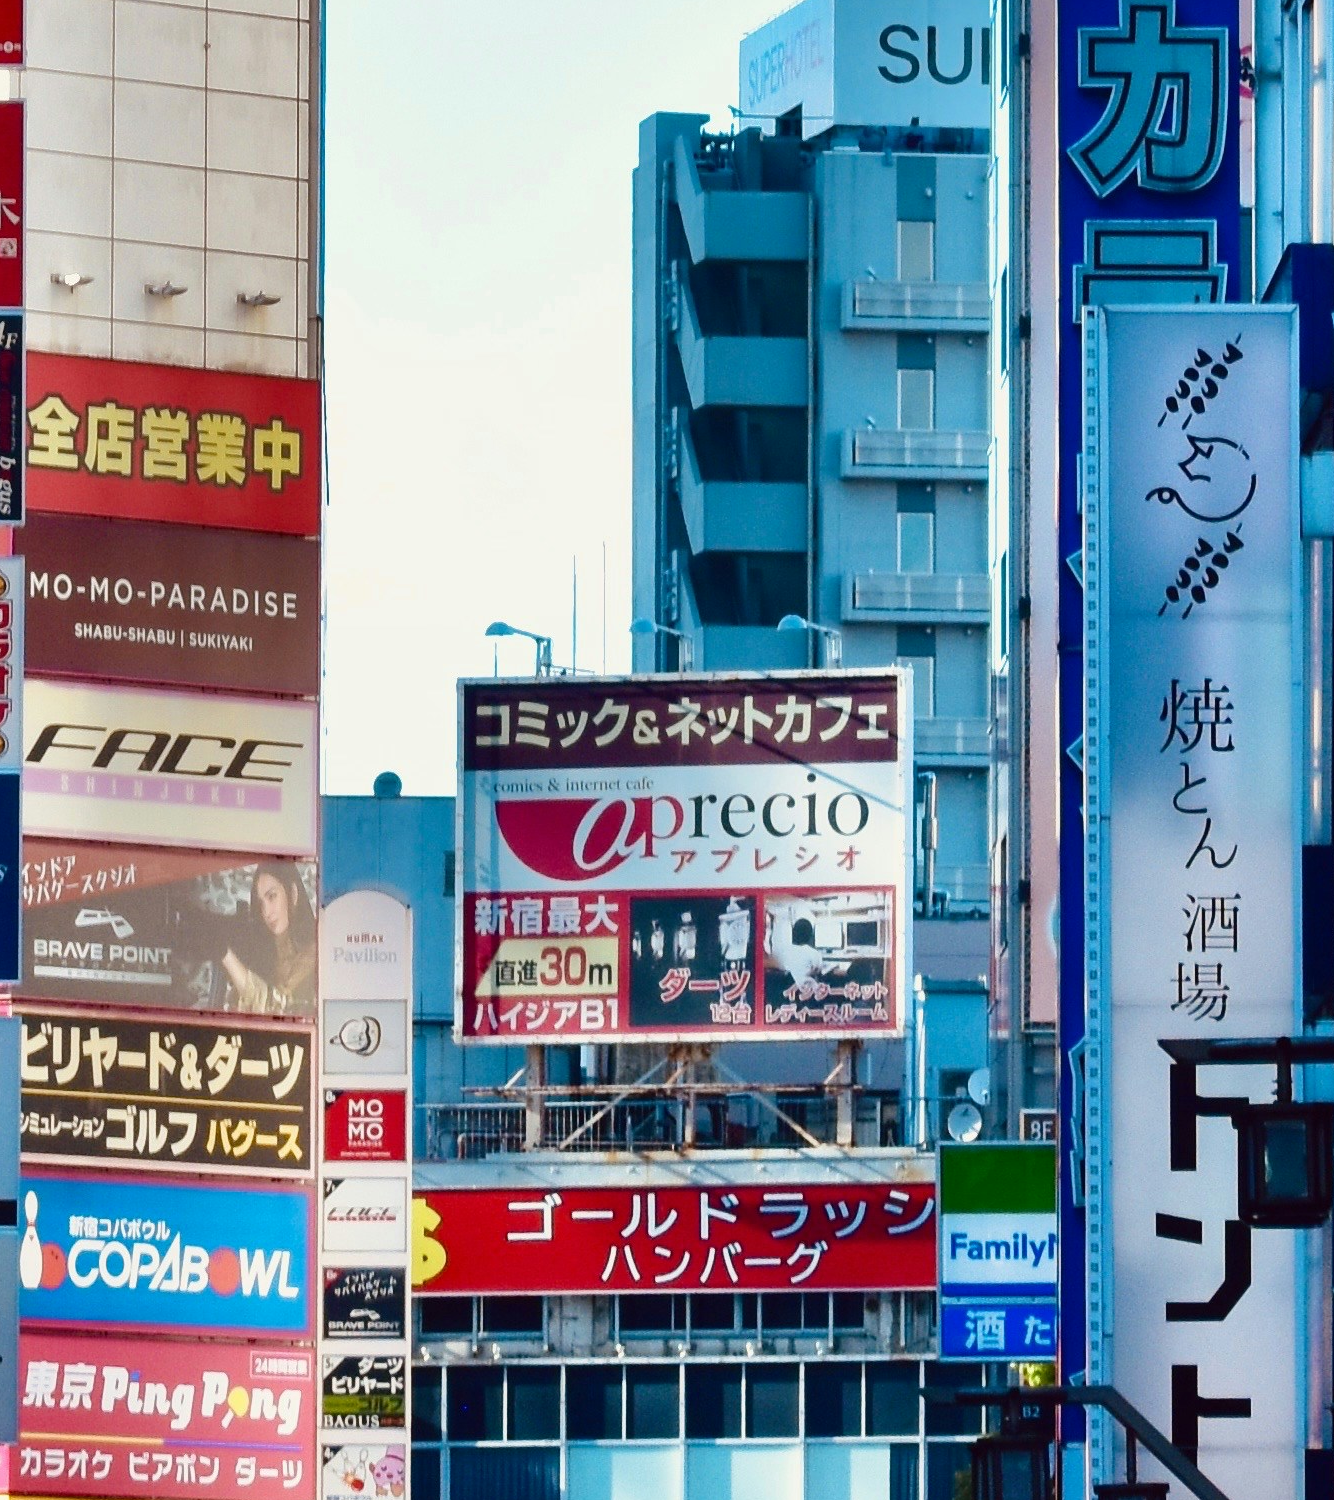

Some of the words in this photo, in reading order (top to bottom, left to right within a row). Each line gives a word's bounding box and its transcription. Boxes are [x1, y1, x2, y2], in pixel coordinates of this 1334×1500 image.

[25, 394, 303, 492] 全店営業中
[28, 571, 298, 619] MO-MO-PARADISE
[74, 622, 176, 646] SHABU-SHABU
[188, 632, 253, 652] SUKIYAKI
[474, 696, 891, 748] コミック&ネットカフェ
[25, 722, 304, 783] FACE
[493, 777, 544, 795] comics
[547, 779, 561, 794] &
[565, 777, 622, 793] internet
[624, 776, 655, 792] cafe
[573, 772, 869, 872] aprecio
[671, 846, 862, 873] アプレシオ
[474, 896, 620, 936] 新宿最大
[33, 938, 104, 963] BRAVE
[108, 944, 173, 966] POINT
[332, 945, 398, 965] Pavilion
[494, 948, 615, 989] 直進30m
[658, 967, 752, 1003] ダーツ
[473, 998, 619, 1031] ハイジアB1
[710, 1002, 752, 1025] 12台
[20, 1020, 305, 1101] ビリヤード&ダーツ
[347, 1098, 384, 1119] MO
[105, 1104, 198, 1158] ゴルフ
[204, 1118, 304, 1163] バグース
[347, 1121, 384, 1142] MO
[1029, 1119, 1055, 1141] 8F
[601, 1242, 829, 1286] ハンバーグ
[328, 1319, 364, 1332] BRAVE
[366, 1320, 401, 1333] POINT
[965, 1308, 1007, 1353] 酒
[357, 1358, 404, 1377] ダーツ
[23, 1360, 95, 1409] 東京
[101, 1365, 196, 1430] Ping
[330, 1376, 405, 1396] ビリヤード
[19, 1449, 113, 1479] カラオケ
[234, 1457, 305, 1489] ダーツ
